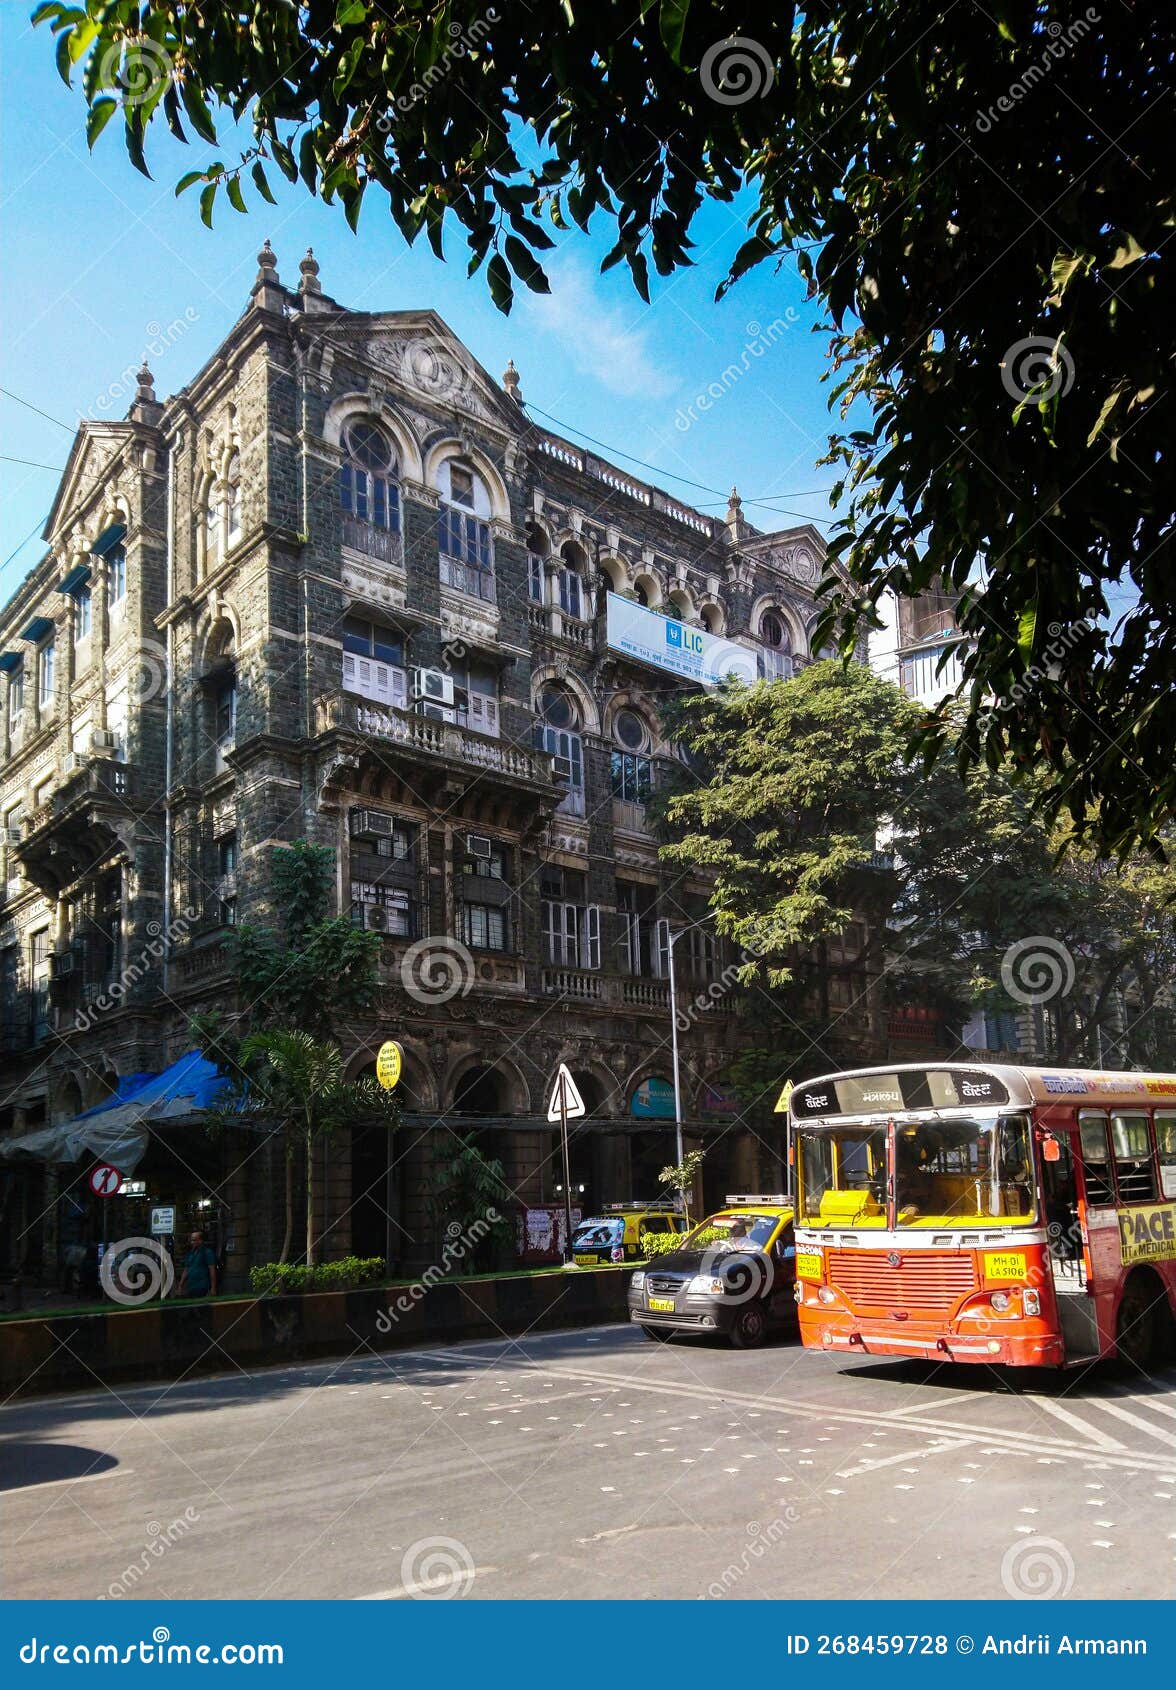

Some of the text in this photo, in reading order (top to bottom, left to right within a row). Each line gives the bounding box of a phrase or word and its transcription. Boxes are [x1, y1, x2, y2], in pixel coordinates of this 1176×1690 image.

[684, 630, 703, 654] LIC
[1118, 1211, 1175, 1245] PACE
[1138, 1240, 1175, 1256] MEDICAL
